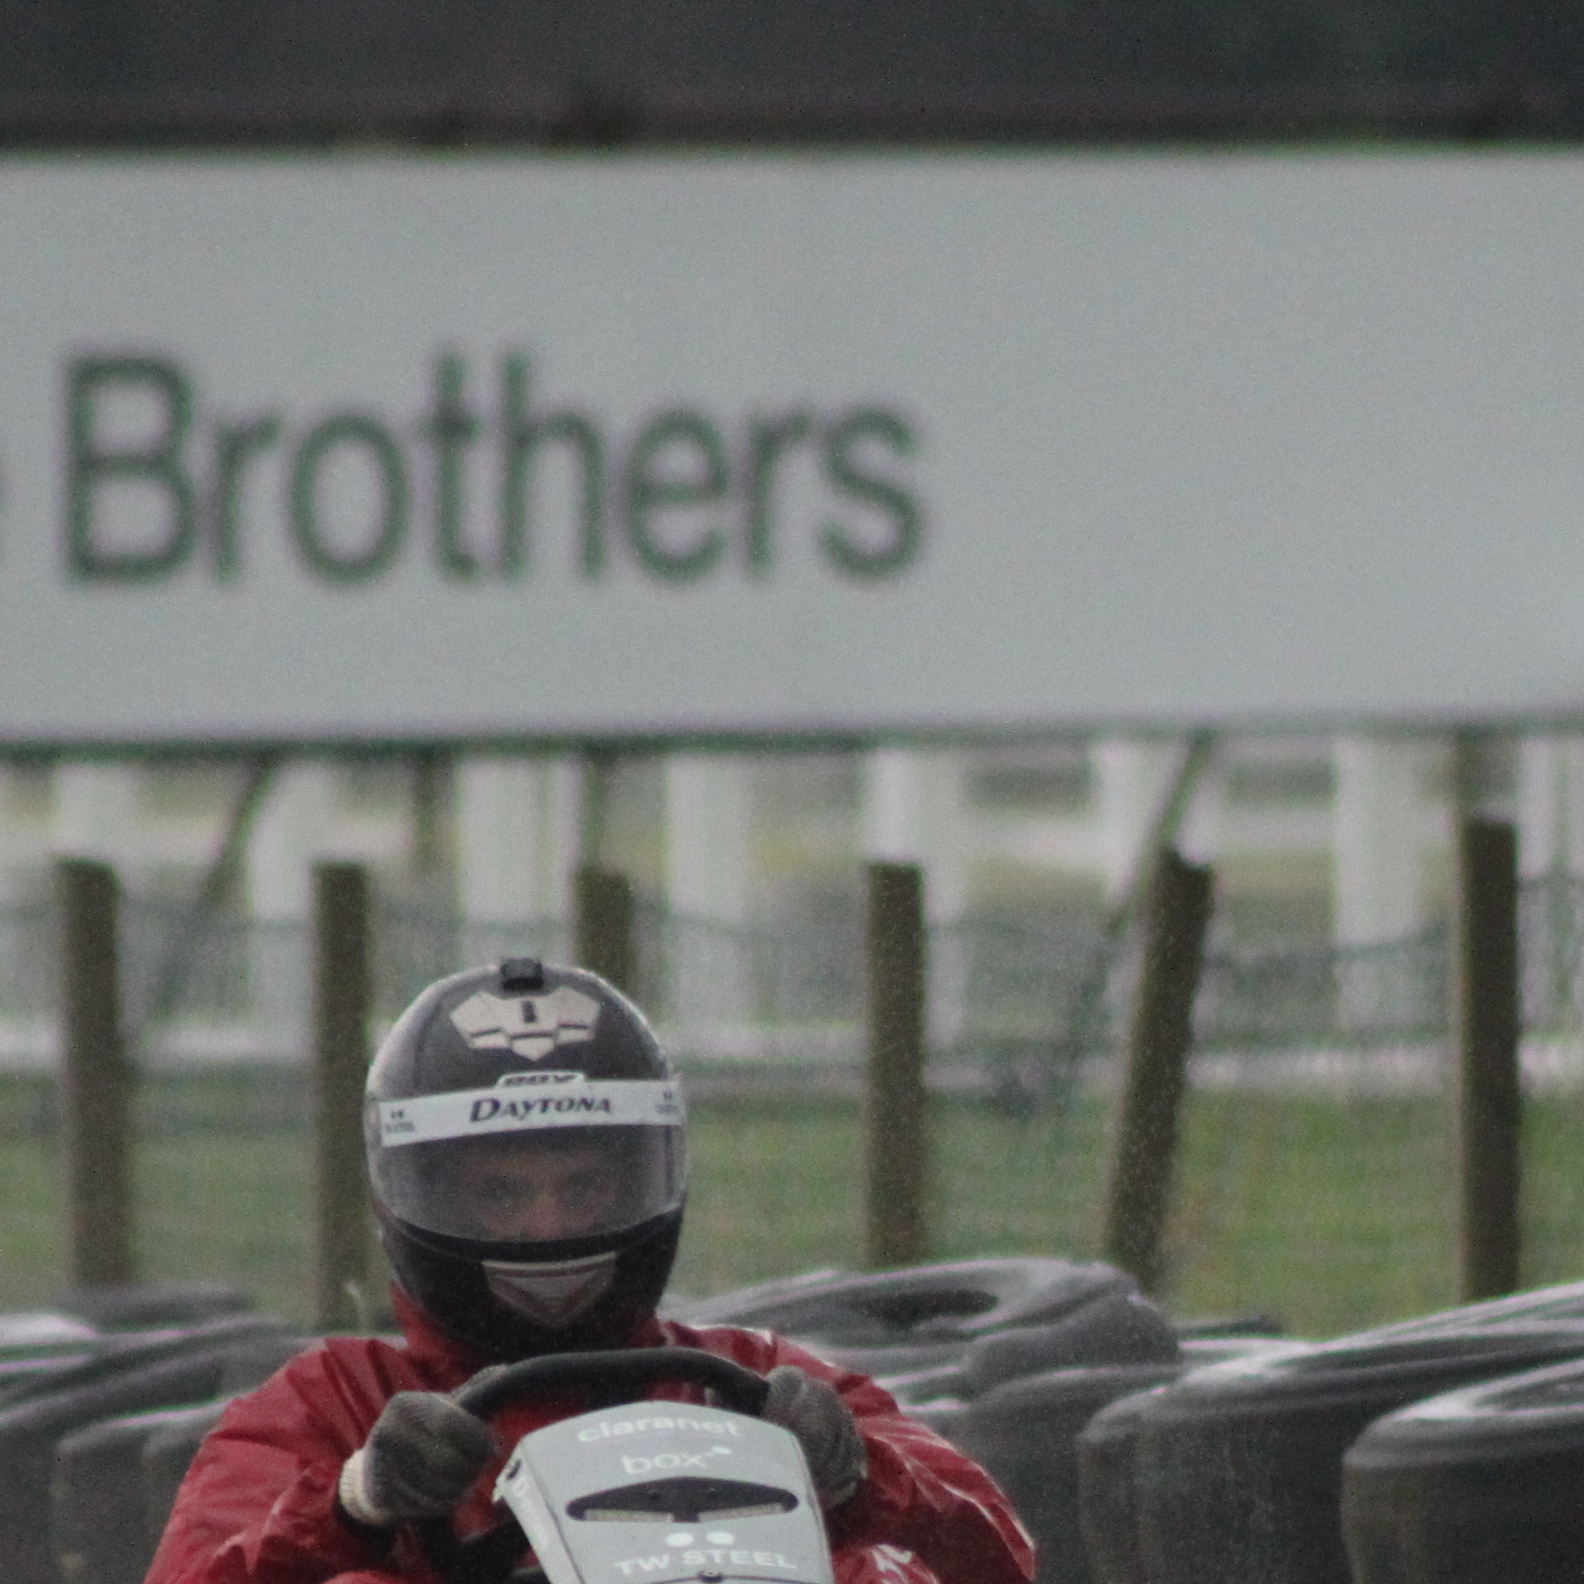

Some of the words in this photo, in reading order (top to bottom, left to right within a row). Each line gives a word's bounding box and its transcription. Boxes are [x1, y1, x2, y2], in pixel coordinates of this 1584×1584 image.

[63, 350, 923, 588] Brothers
[470, 1096, 612, 1122] DAYTONA
[577, 1416, 741, 1442] claranet
[621, 1453, 708, 1475] box
[614, 1553, 671, 1576] TW
[680, 1550, 798, 1570] STEEL
